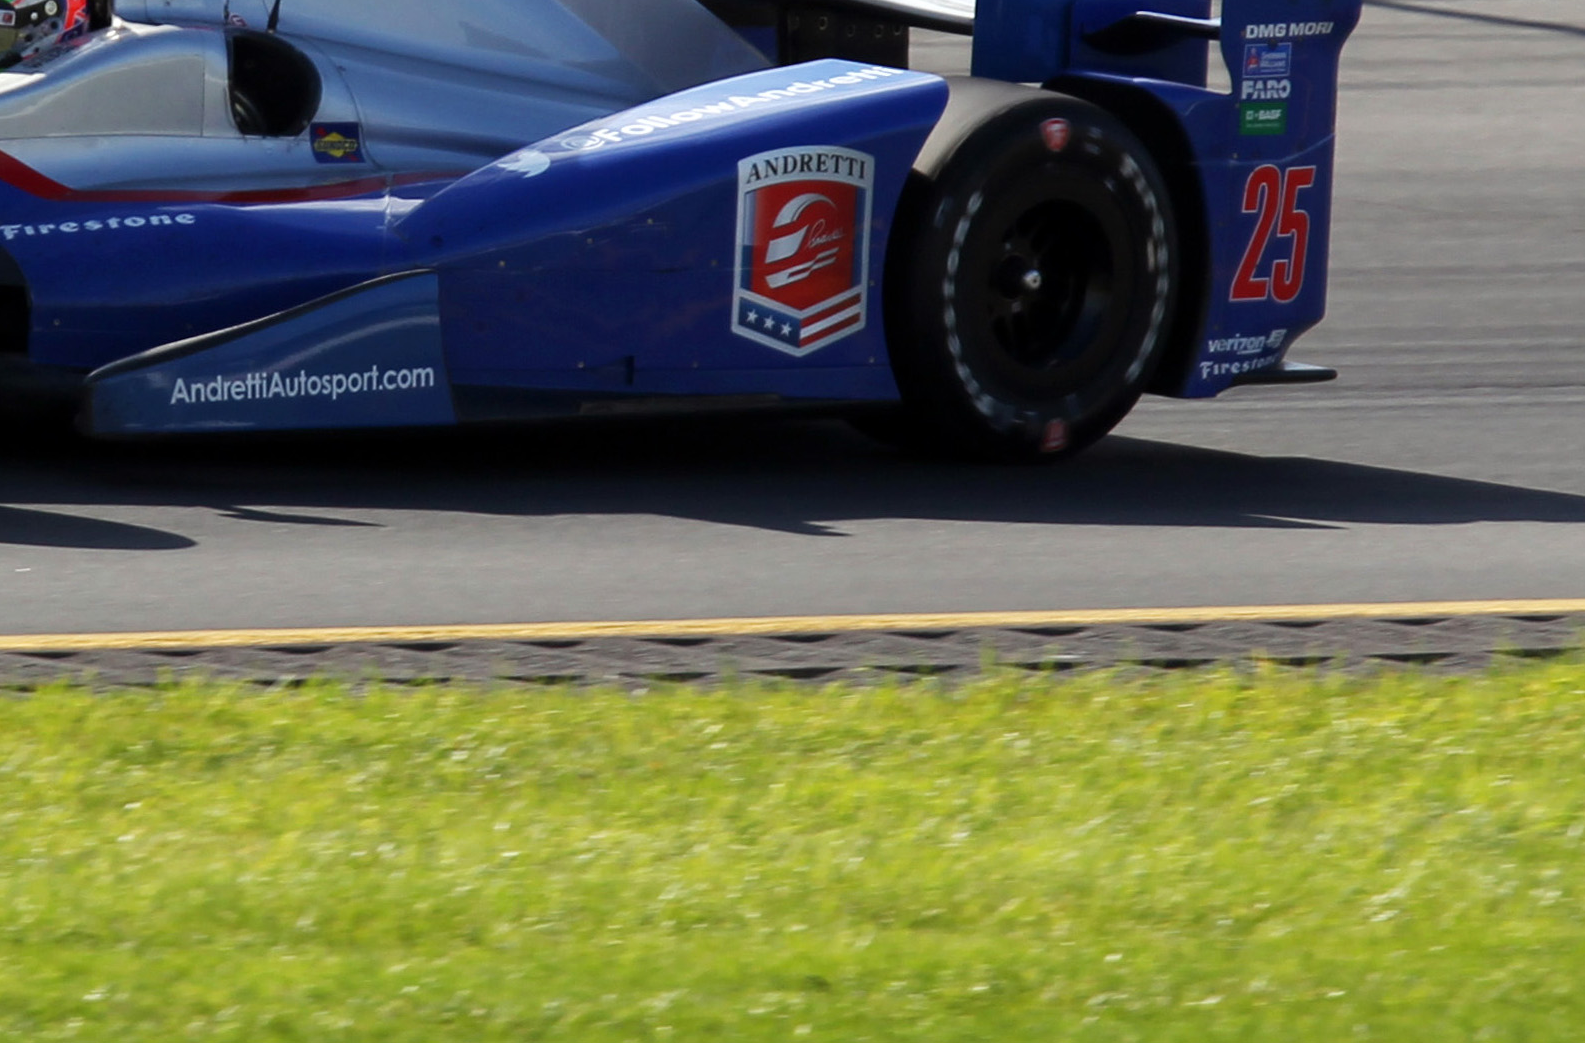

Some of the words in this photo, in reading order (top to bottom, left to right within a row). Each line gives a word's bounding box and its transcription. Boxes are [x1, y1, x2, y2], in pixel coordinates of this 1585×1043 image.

[1245, 23, 1287, 39] DMG
[1289, 22, 1334, 37] MORI
[1240, 78, 1292, 100] FARO
[561, 66, 904, 151] @FollowAndretti
[745, 152, 868, 184] ANDRETTI
[1228, 163, 1317, 304] 25
[1208, 333, 1267, 355] verizon
[170, 365, 435, 405] AndrettiAutosport.com
